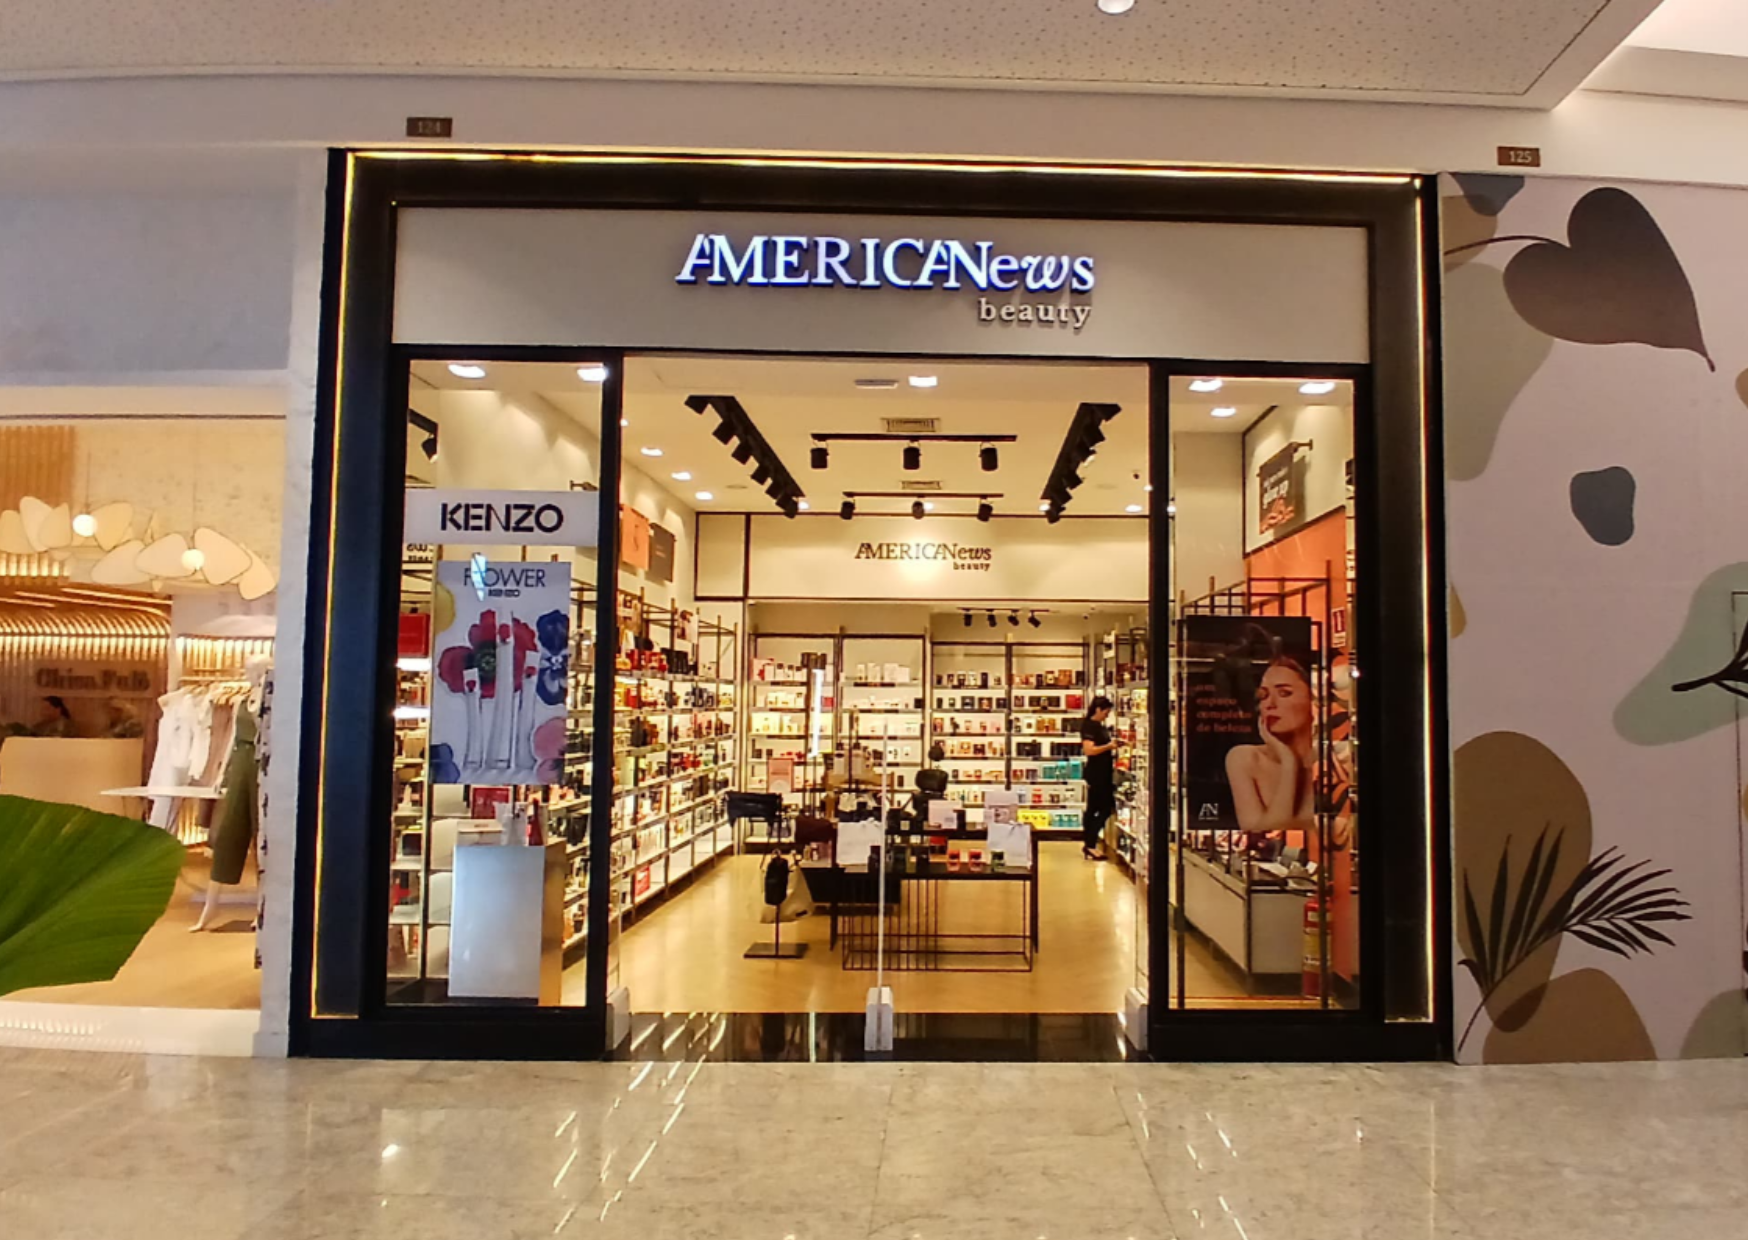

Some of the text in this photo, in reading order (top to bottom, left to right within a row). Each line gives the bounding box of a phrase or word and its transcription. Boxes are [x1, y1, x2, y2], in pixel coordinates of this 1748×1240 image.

[1509, 150, 1532, 163] 125
[978, 297, 1092, 329] beauty
[440, 502, 564, 533] KENZO
[952, 561, 991, 572] beauty
[463, 567, 546, 588] FOWER
